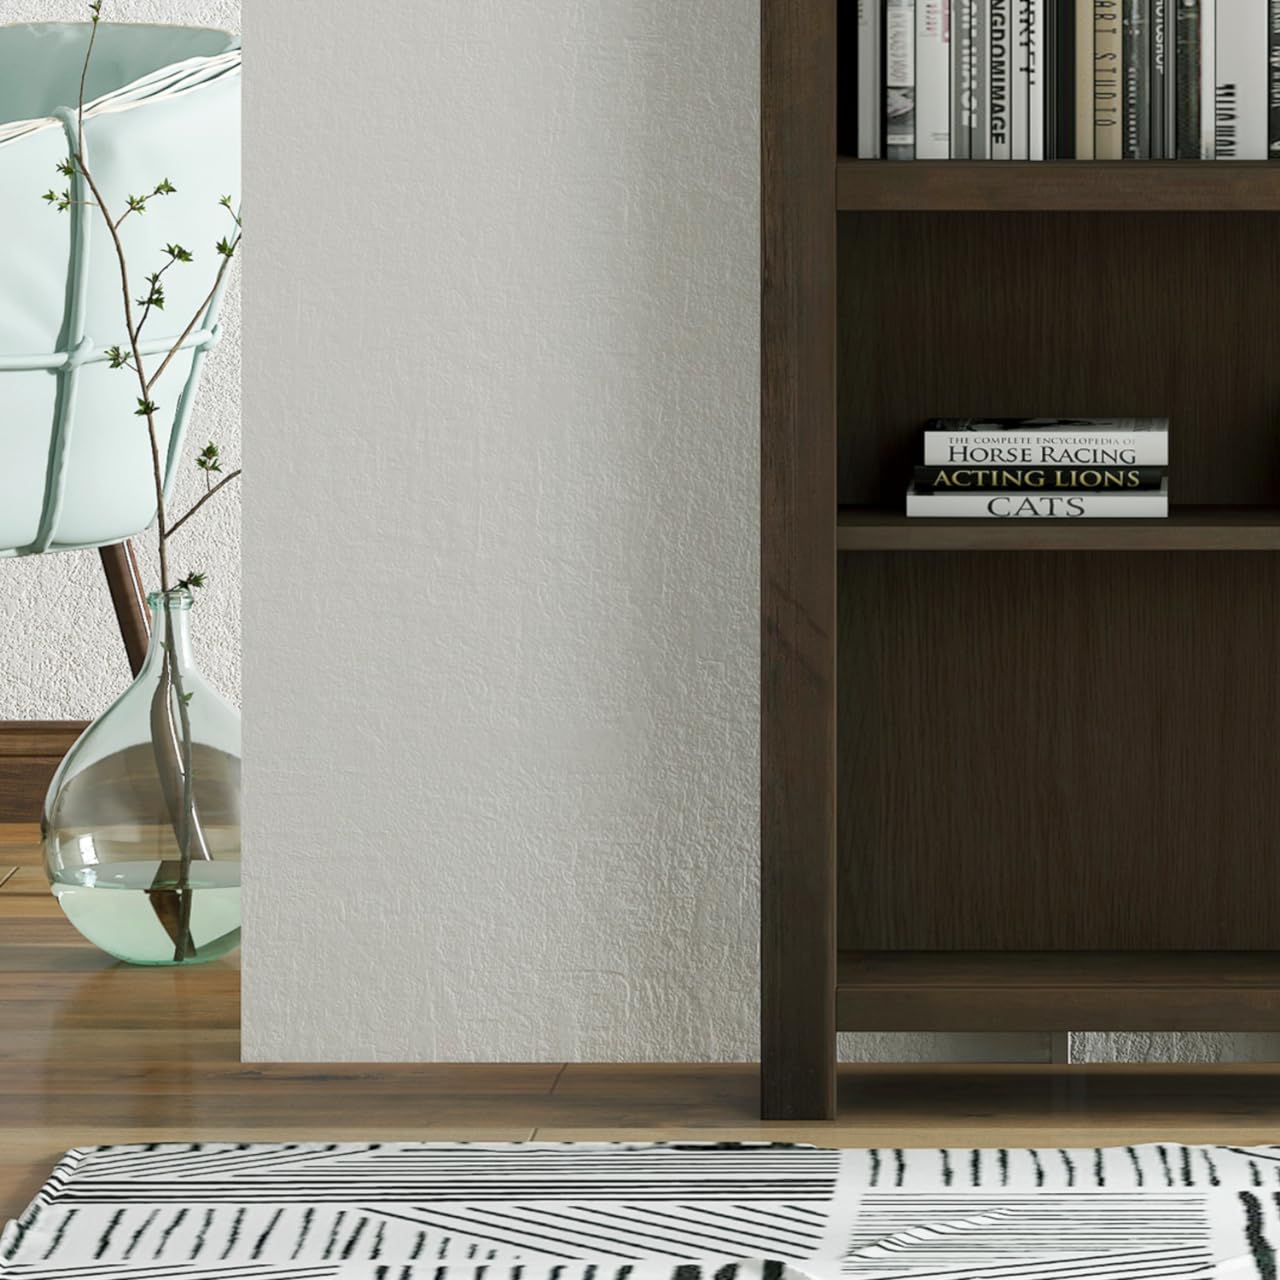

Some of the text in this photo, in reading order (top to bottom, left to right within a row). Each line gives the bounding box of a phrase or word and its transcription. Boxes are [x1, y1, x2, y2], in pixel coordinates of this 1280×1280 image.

[1095, 1, 1116, 34] ART
[1095, 52, 1116, 126] STUDIO
[949, 437, 971, 445] THE
[974, 437, 1032, 445] COMPLETE
[1036, 437, 1119, 445] ENCYCLOPEDIA
[934, 470, 1140, 487] ACTING LIONS
[987, 496, 1085, 517] CATS
